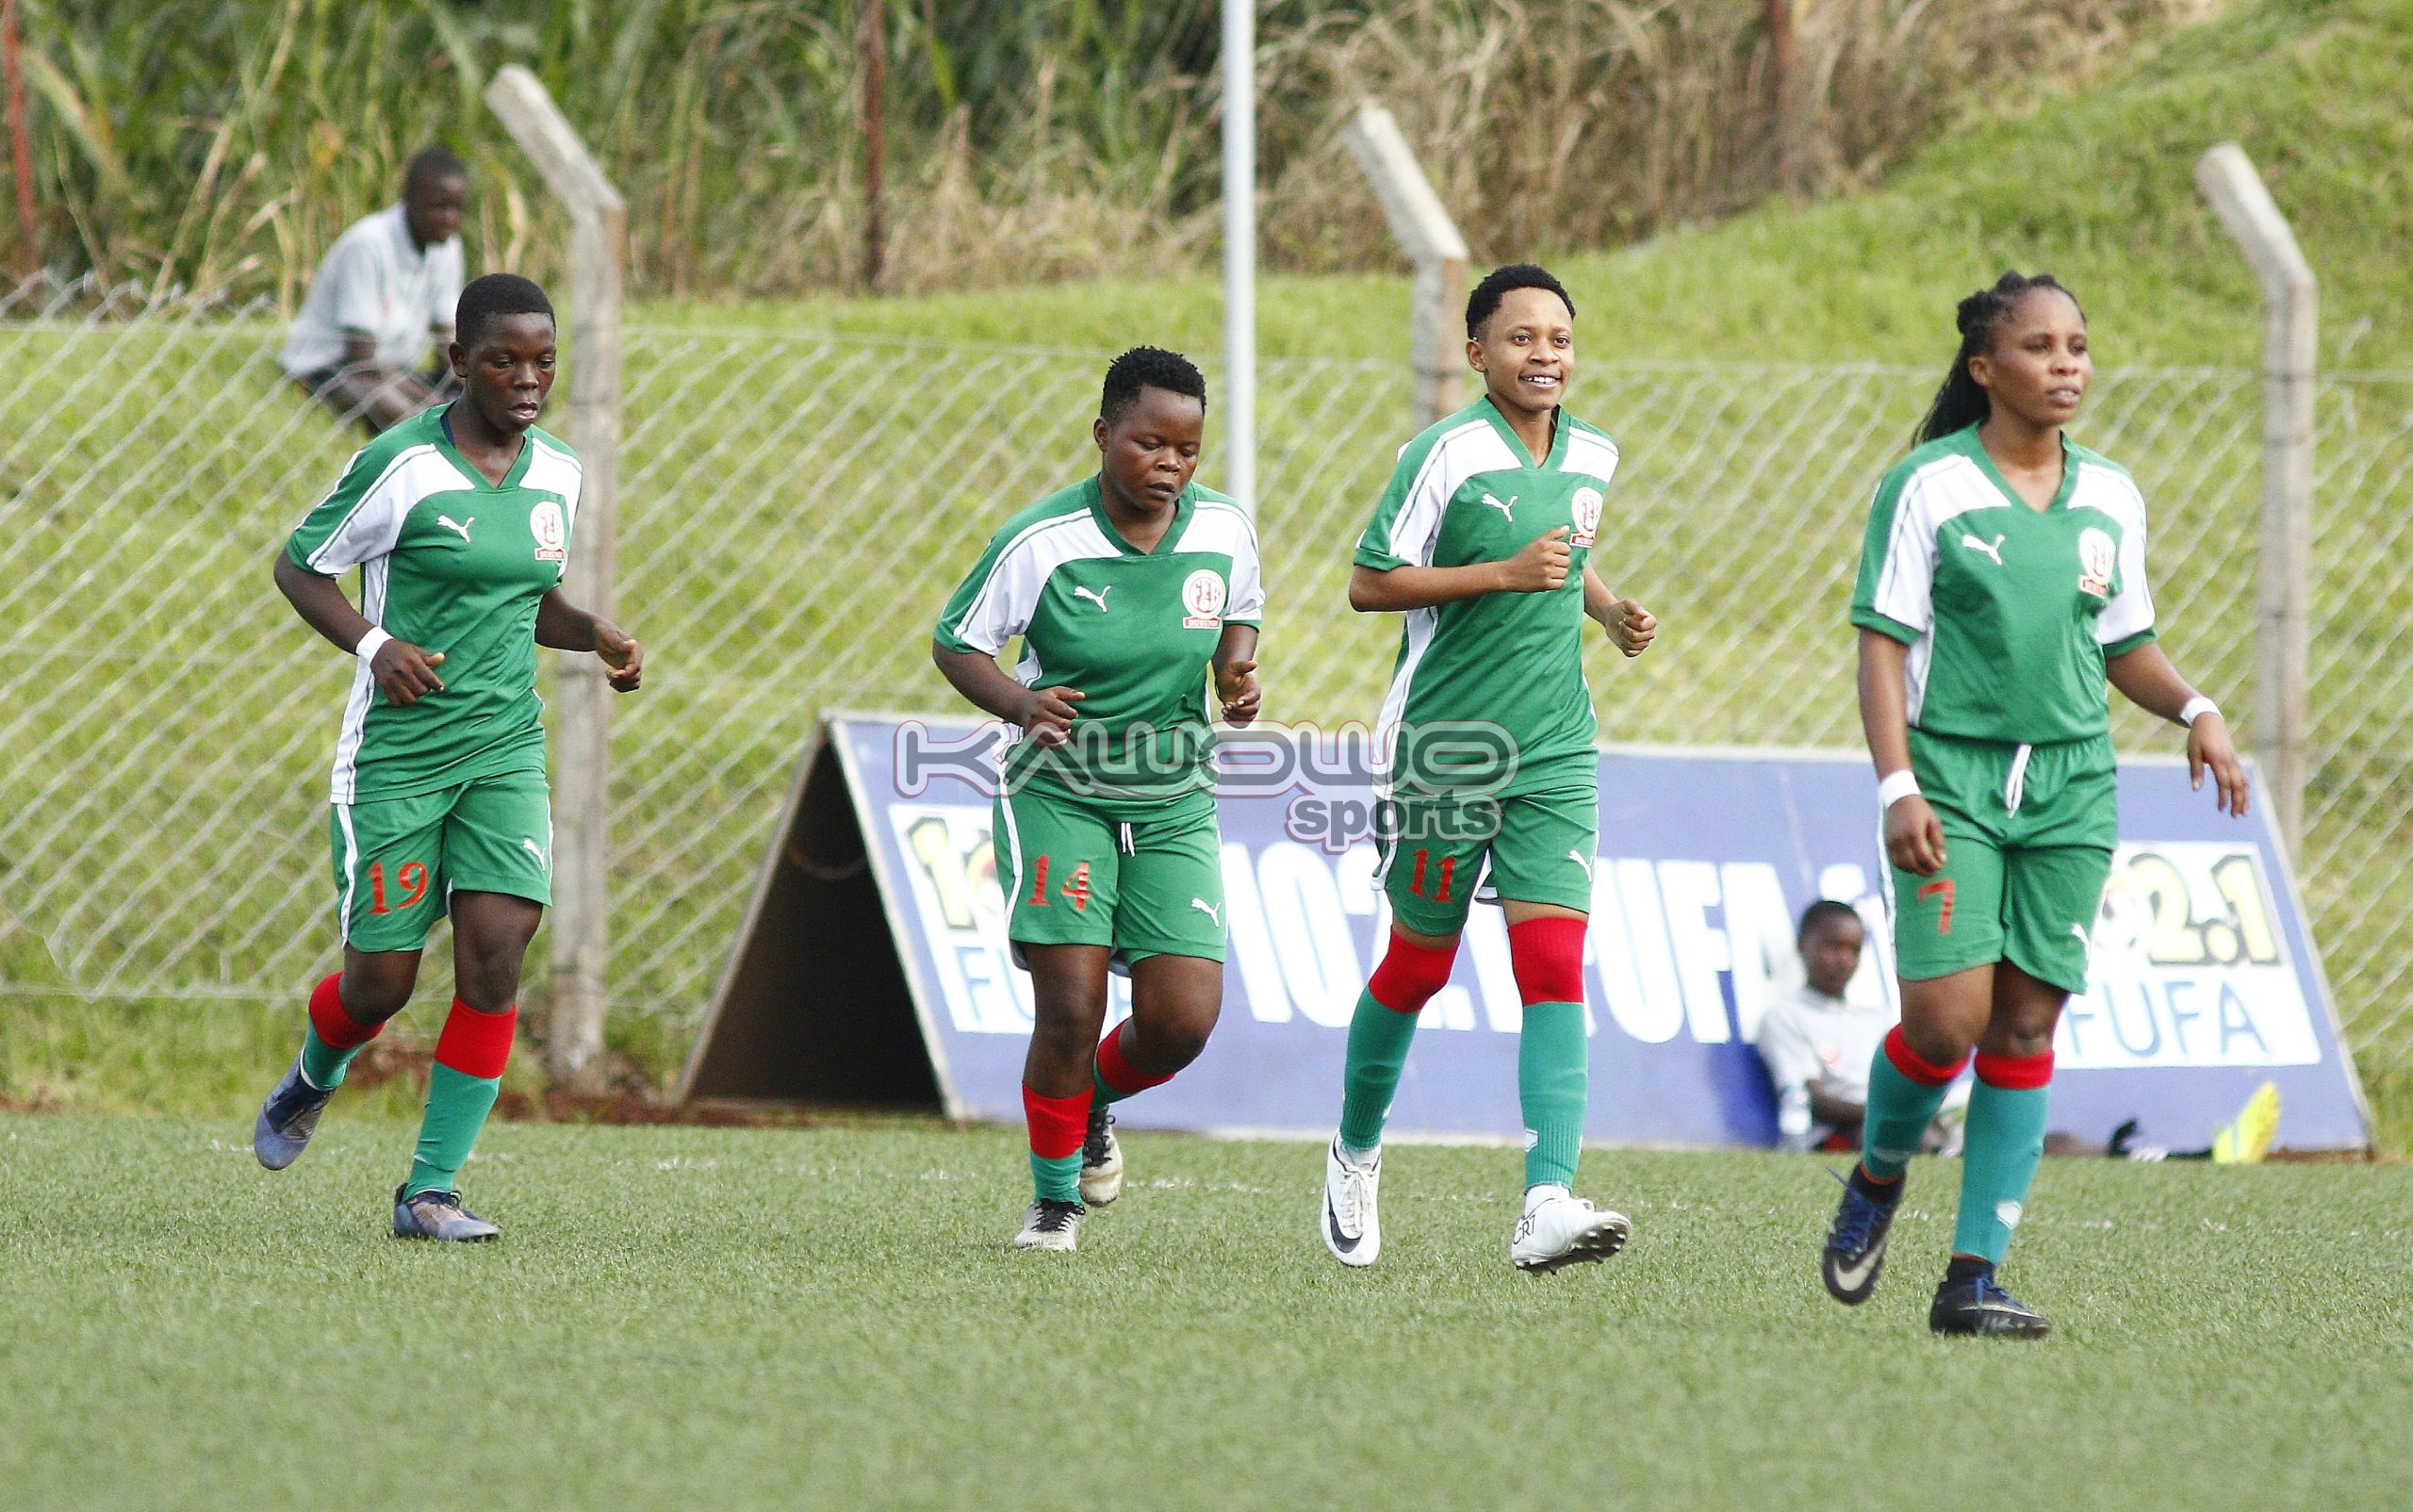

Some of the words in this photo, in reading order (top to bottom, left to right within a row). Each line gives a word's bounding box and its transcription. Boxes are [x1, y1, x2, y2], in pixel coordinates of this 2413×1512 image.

[367, 861, 429, 915] 19
[1026, 853, 1092, 912] 14
[1407, 848, 1457, 903] 11
[1916, 879, 1956, 935] 7
[1584, 856, 1806, 1044] UFA
